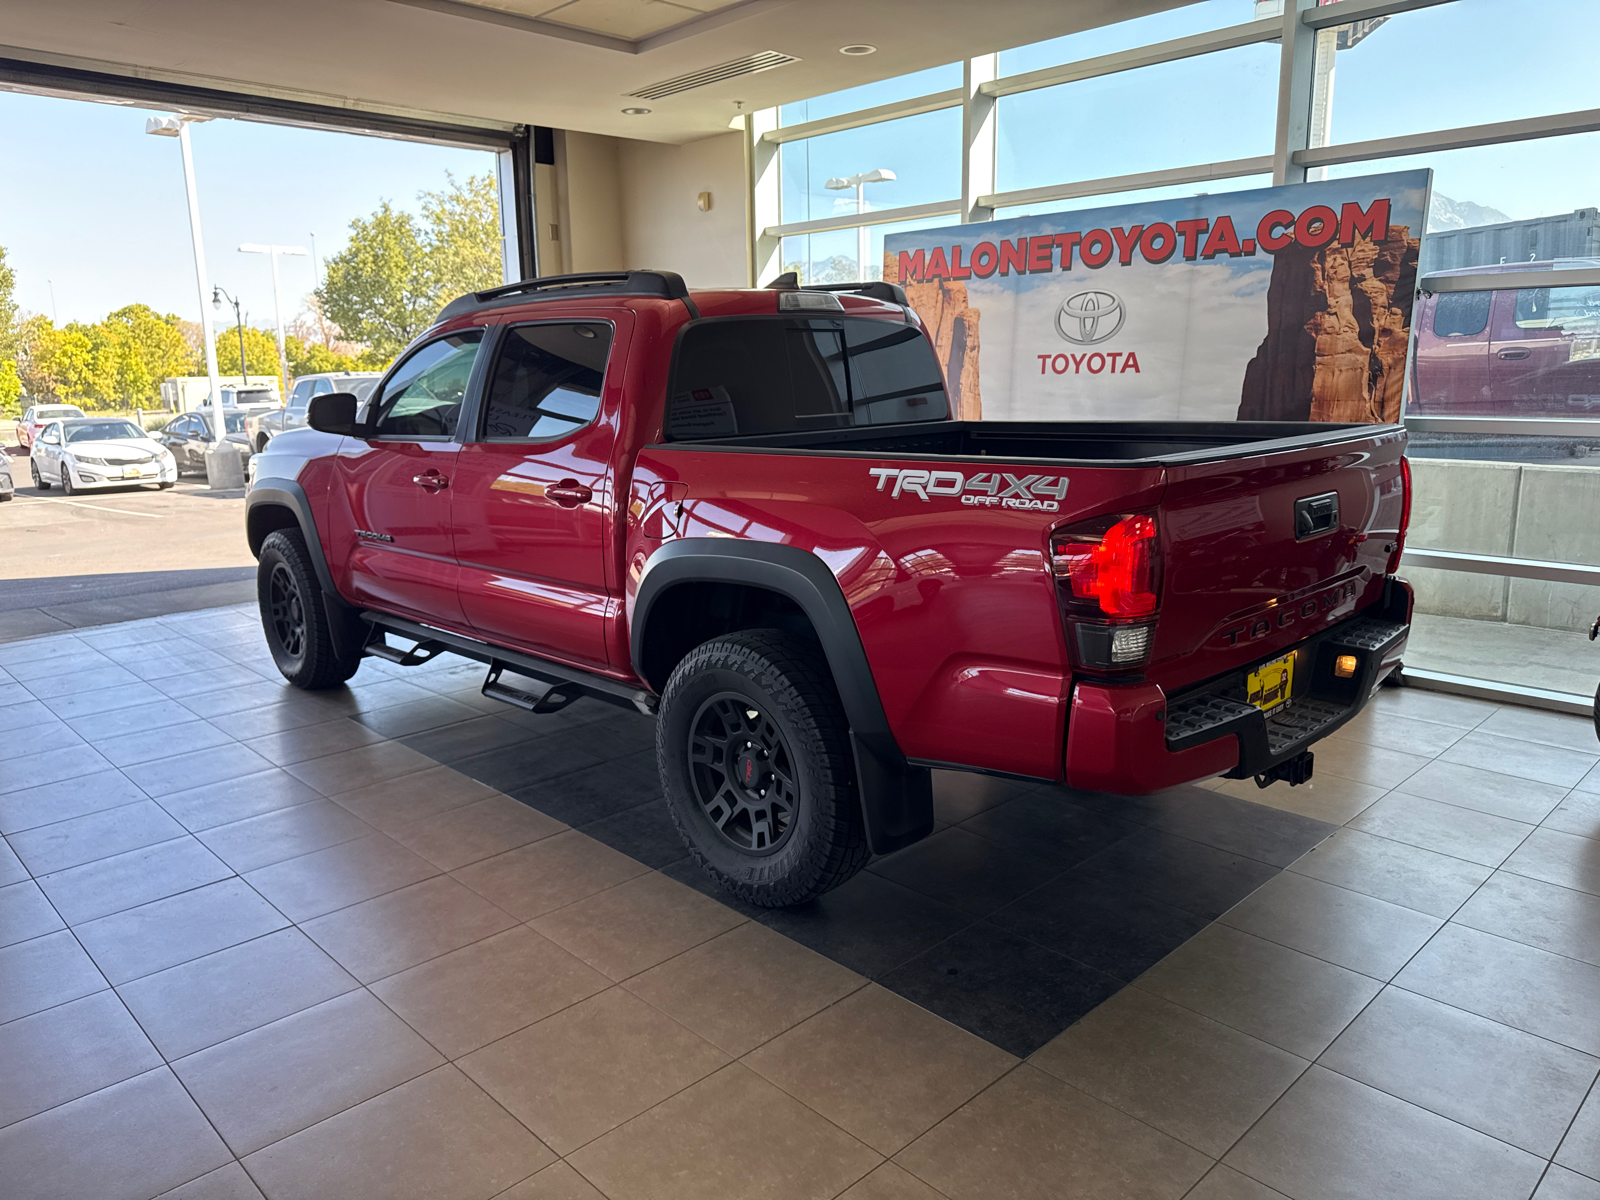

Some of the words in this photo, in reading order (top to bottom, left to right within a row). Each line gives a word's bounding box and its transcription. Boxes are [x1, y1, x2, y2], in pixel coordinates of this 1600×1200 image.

[898, 198, 1392, 285] MALONETOYOTA.COM
[1037, 351, 1141, 375] TOYOTA
[869, 467, 964, 502] TRD
[961, 494, 1000, 507] OFF
[1001, 497, 1060, 512] ROAD
[354, 529, 395, 543] TACOMA
[1222, 581, 1358, 647] TACOMA
